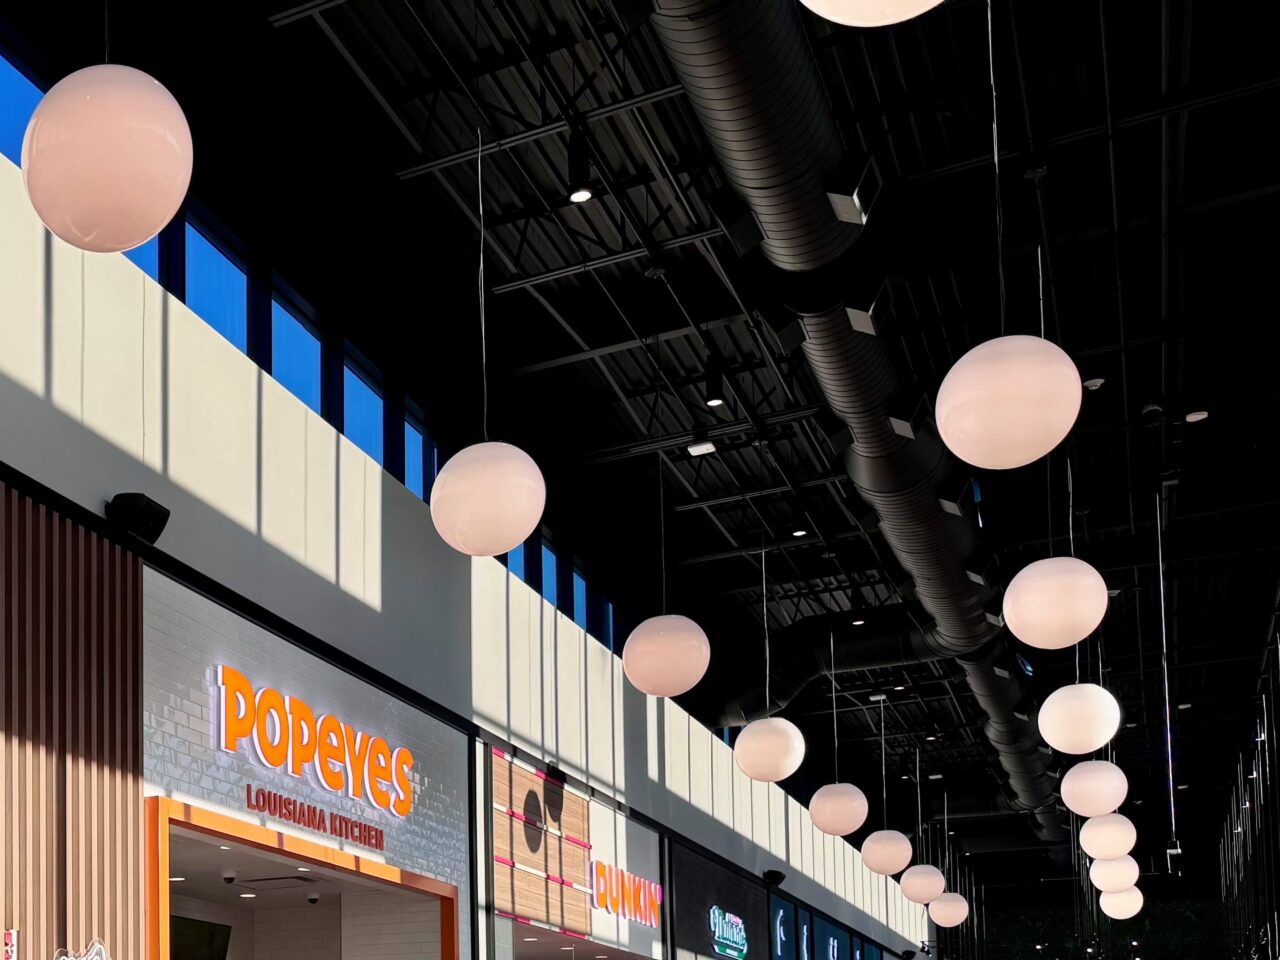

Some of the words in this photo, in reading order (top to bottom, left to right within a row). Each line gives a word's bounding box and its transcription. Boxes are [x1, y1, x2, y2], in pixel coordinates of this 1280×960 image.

[246, 784, 327, 834] LOUISIANA
[330, 812, 385, 851] KITCHEN
[592, 860, 663, 928] DUNKIN'
